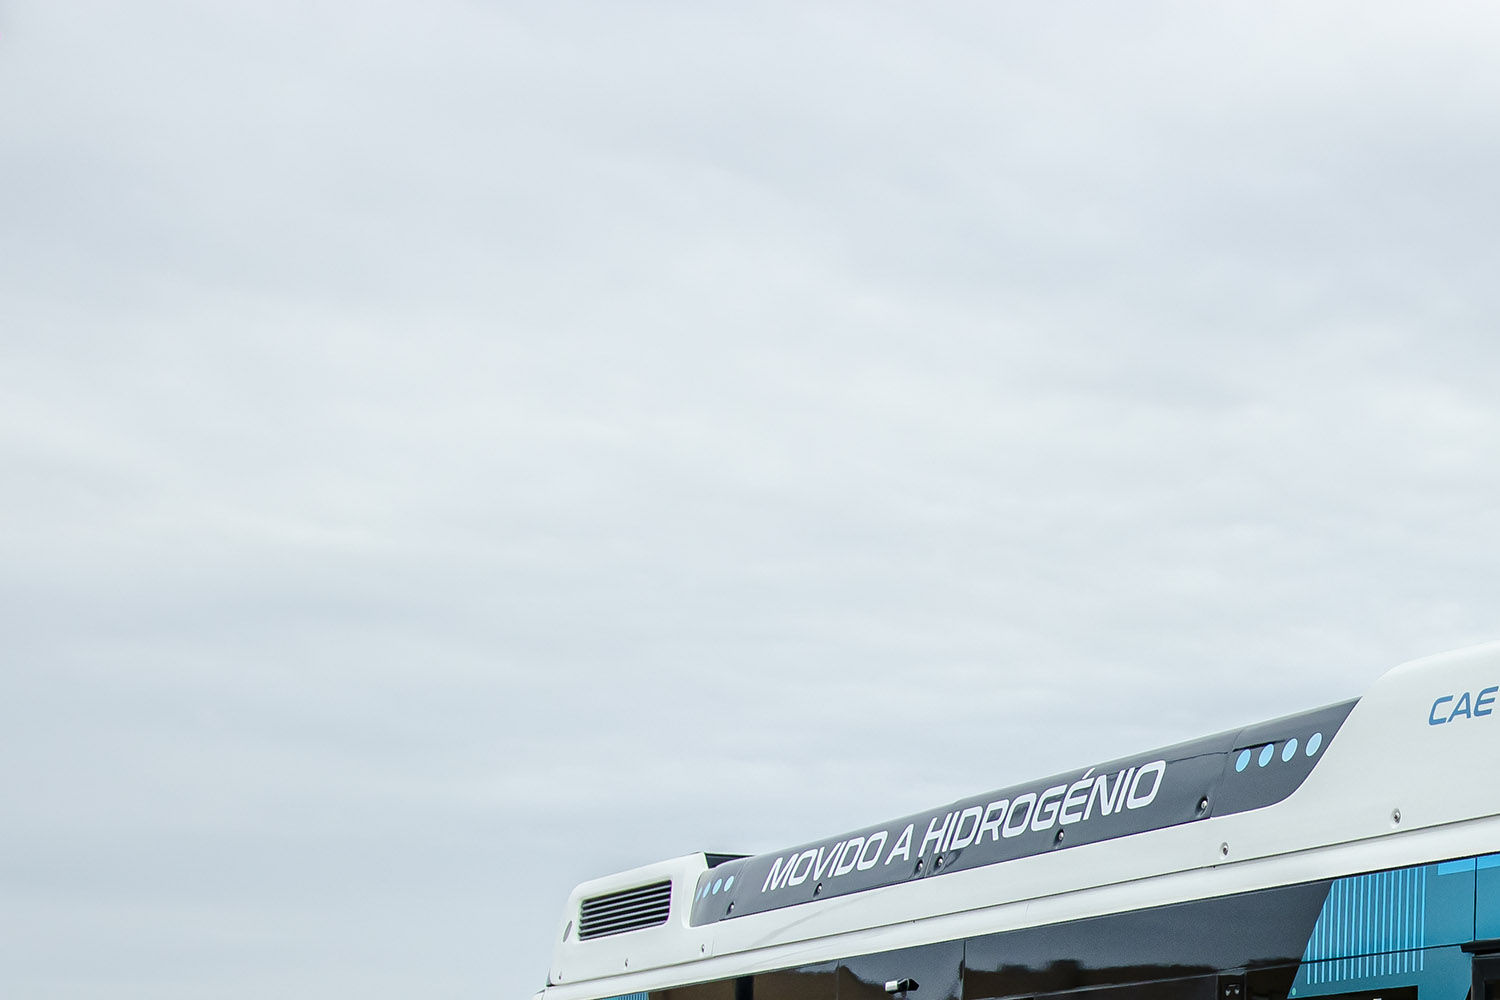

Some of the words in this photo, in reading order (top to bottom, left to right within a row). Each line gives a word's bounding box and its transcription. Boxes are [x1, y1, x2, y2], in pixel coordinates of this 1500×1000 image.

[761, 830, 889, 893] MOVIDO
[884, 823, 915, 865] A
[918, 760, 1167, 858] HIDROGÉNIO
